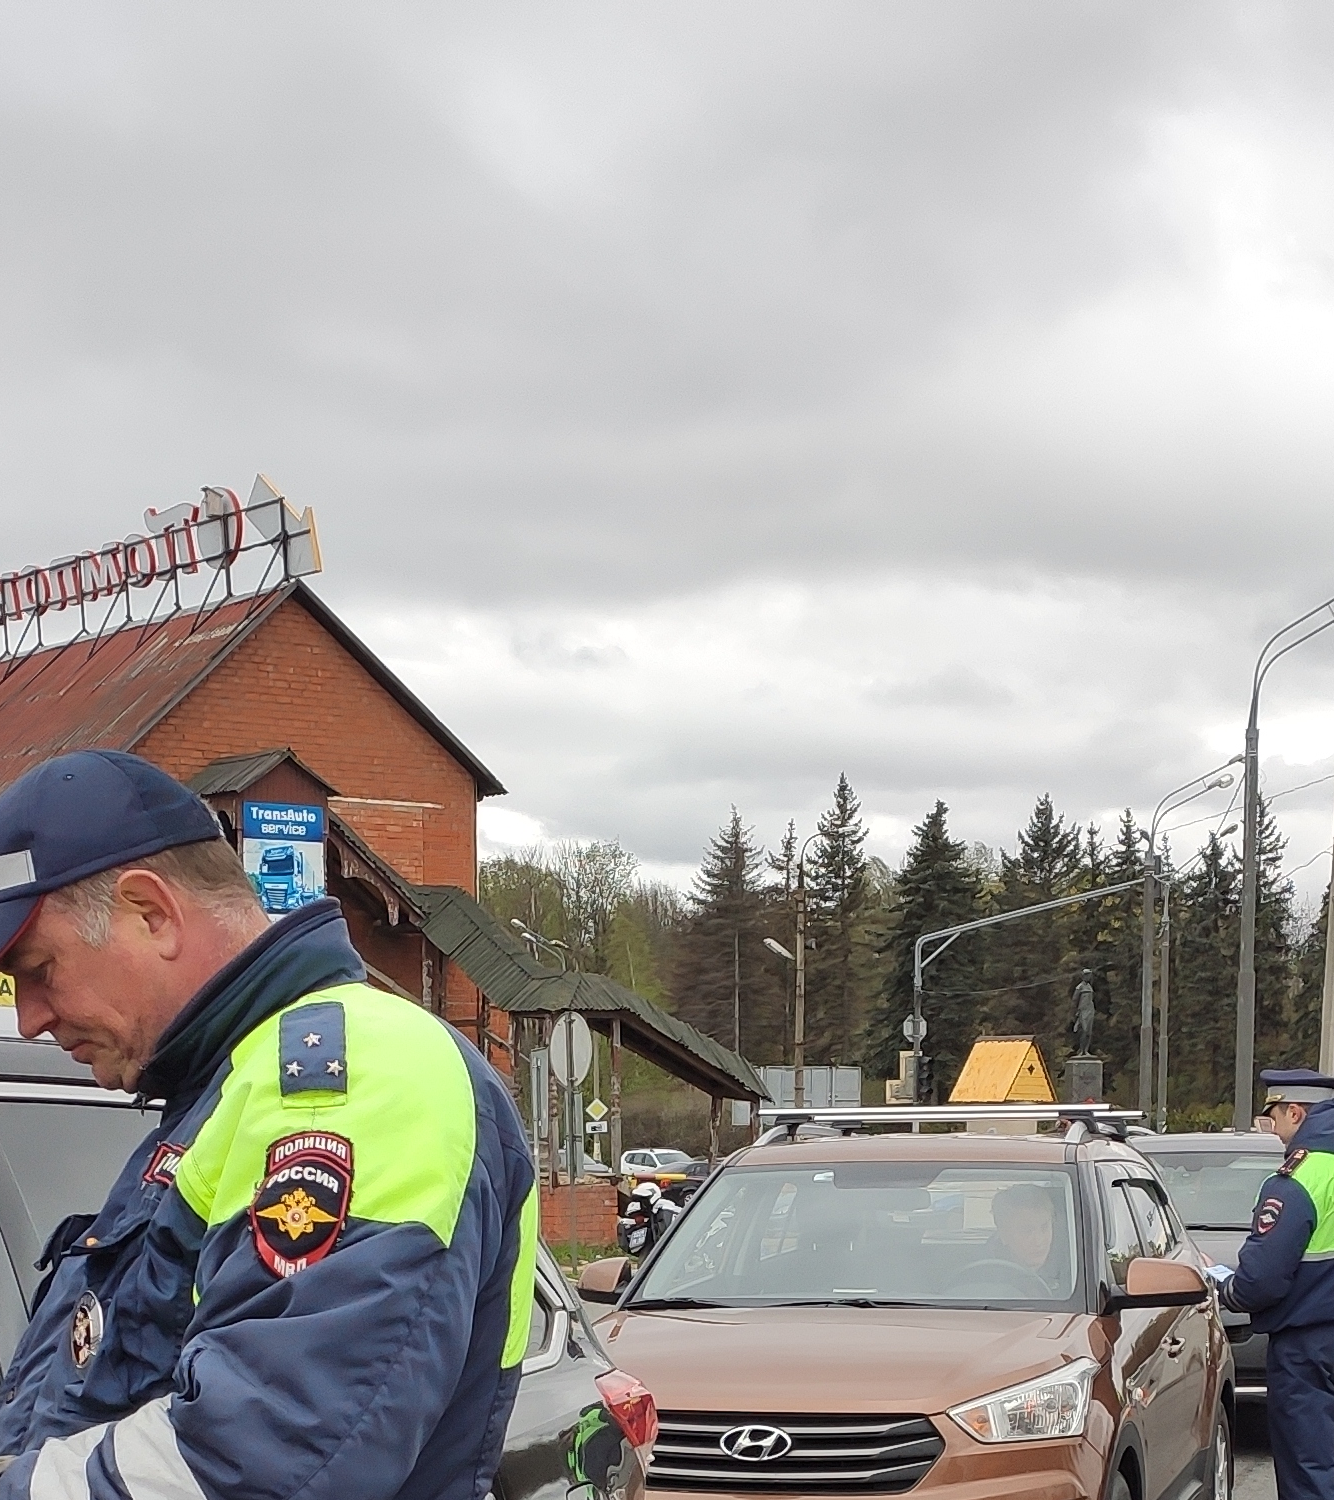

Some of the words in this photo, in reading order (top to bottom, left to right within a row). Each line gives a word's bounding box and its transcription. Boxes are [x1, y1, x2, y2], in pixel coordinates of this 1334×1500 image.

[250, 806, 316, 823] TransAuto
[261, 822, 306, 836] service
[274, 1136, 347, 1163] ПОЛИЦИЯ
